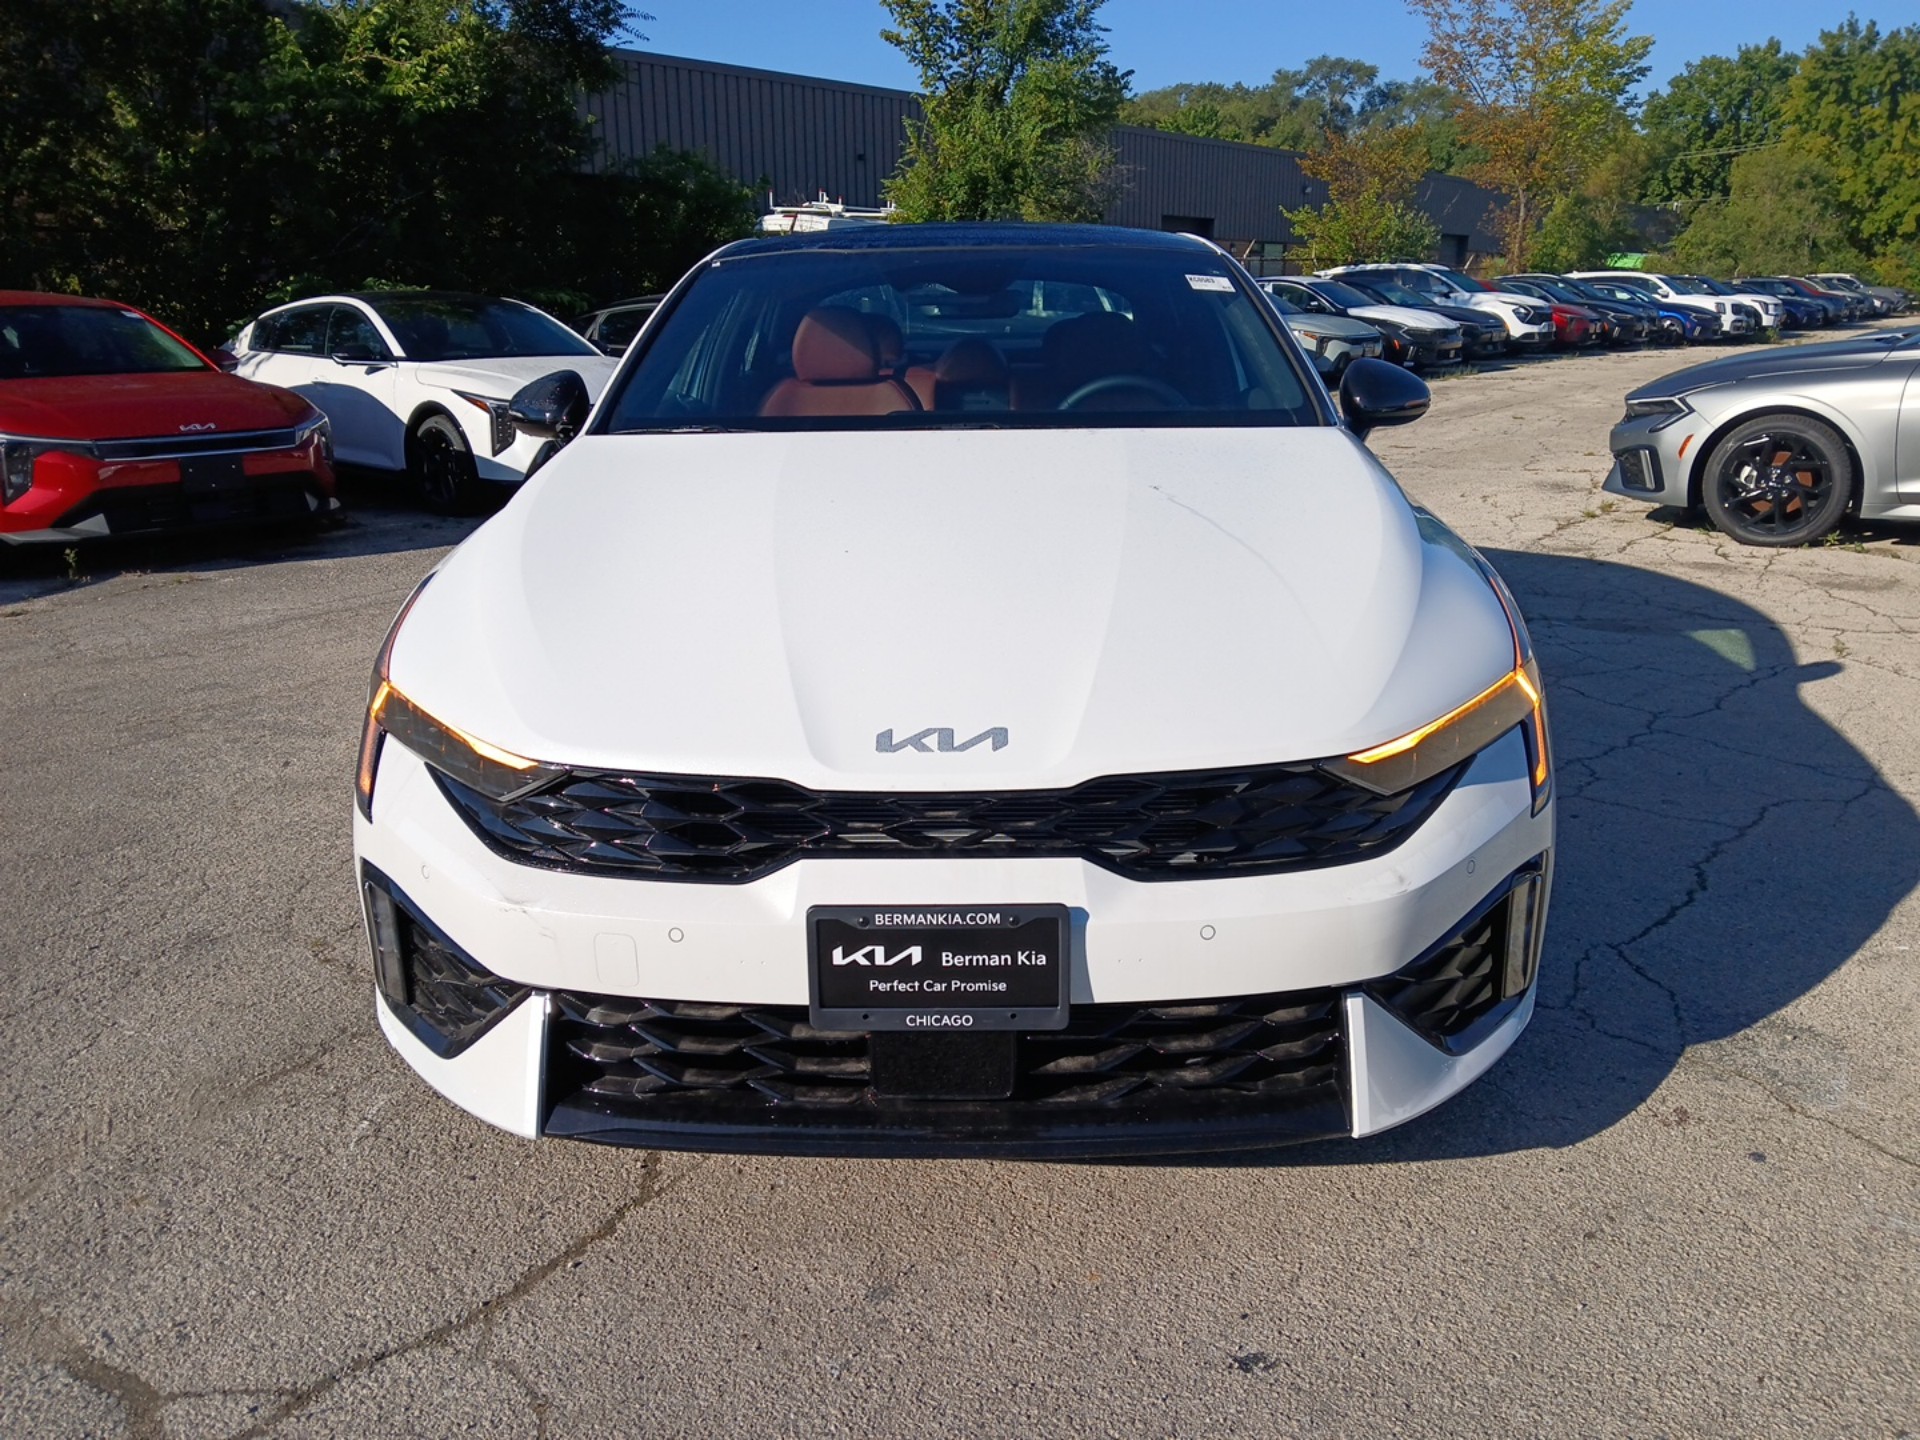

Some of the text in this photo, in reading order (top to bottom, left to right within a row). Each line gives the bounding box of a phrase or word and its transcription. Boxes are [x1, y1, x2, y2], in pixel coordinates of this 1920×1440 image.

[179, 422, 217, 431] KIA
[875, 727, 1009, 753] KIA
[874, 912, 1002, 927] BERMANKIA.COM
[831, 944, 923, 967] KIA
[941, 950, 1047, 967] Berman Kia
[869, 979, 1007, 992] Perfect Car Promise
[905, 1014, 974, 1027] CHICAGO
